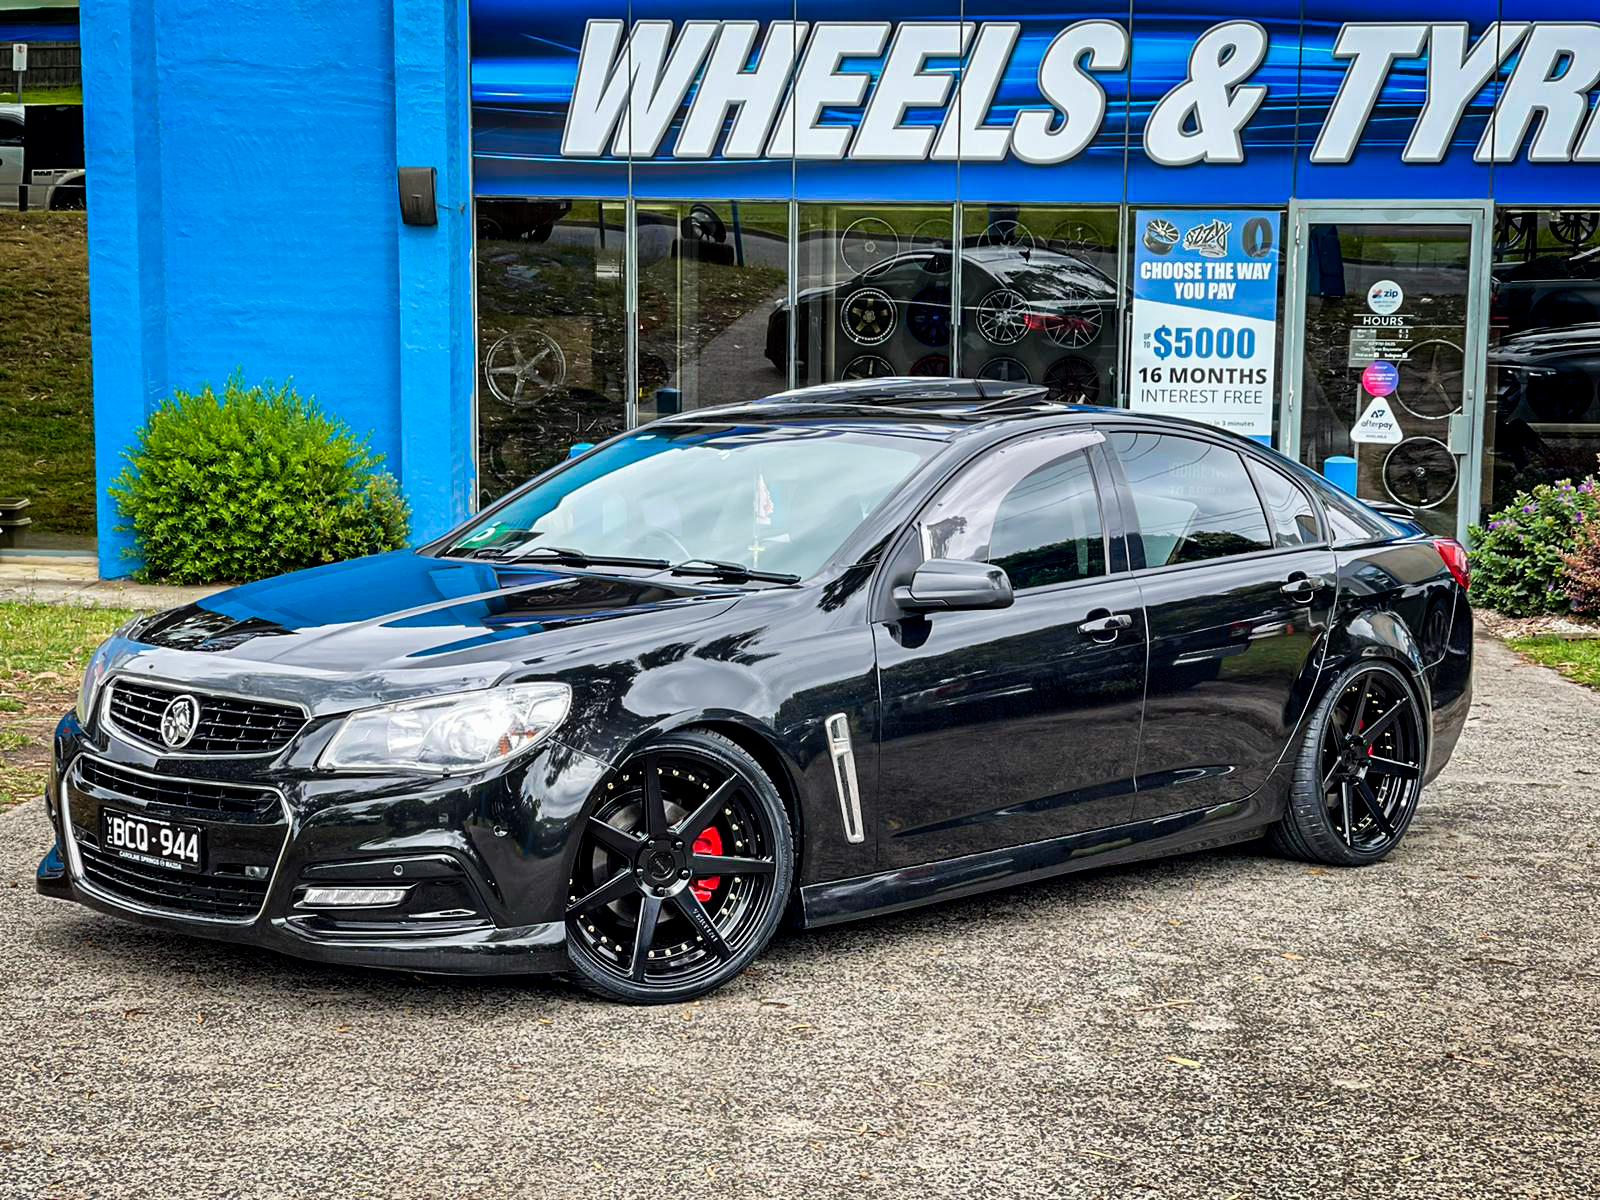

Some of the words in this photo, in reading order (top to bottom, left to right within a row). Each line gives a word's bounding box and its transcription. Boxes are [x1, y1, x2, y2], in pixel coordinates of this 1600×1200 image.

[560, 19, 1130, 165] WHEELS
[1143, 19, 1268, 165] &
[1309, 21, 1600, 164] TYR
[1140, 262, 1202, 280] CHOOSE
[1205, 262, 1234, 280] THE
[1237, 262, 1272, 280] WAY
[1174, 282, 1205, 300] YOU
[1208, 282, 1237, 300] PAY
[1383, 289, 1399, 298] zip
[1363, 316, 1404, 326] HOURS
[1153, 324, 1256, 360] $5000
[1138, 367, 1162, 384] 16
[1169, 367, 1268, 385] MONTHS
[1141, 388, 1219, 404] INTEREST
[1223, 390, 1263, 405] FREE
[1361, 420, 1393, 430] afterpay
